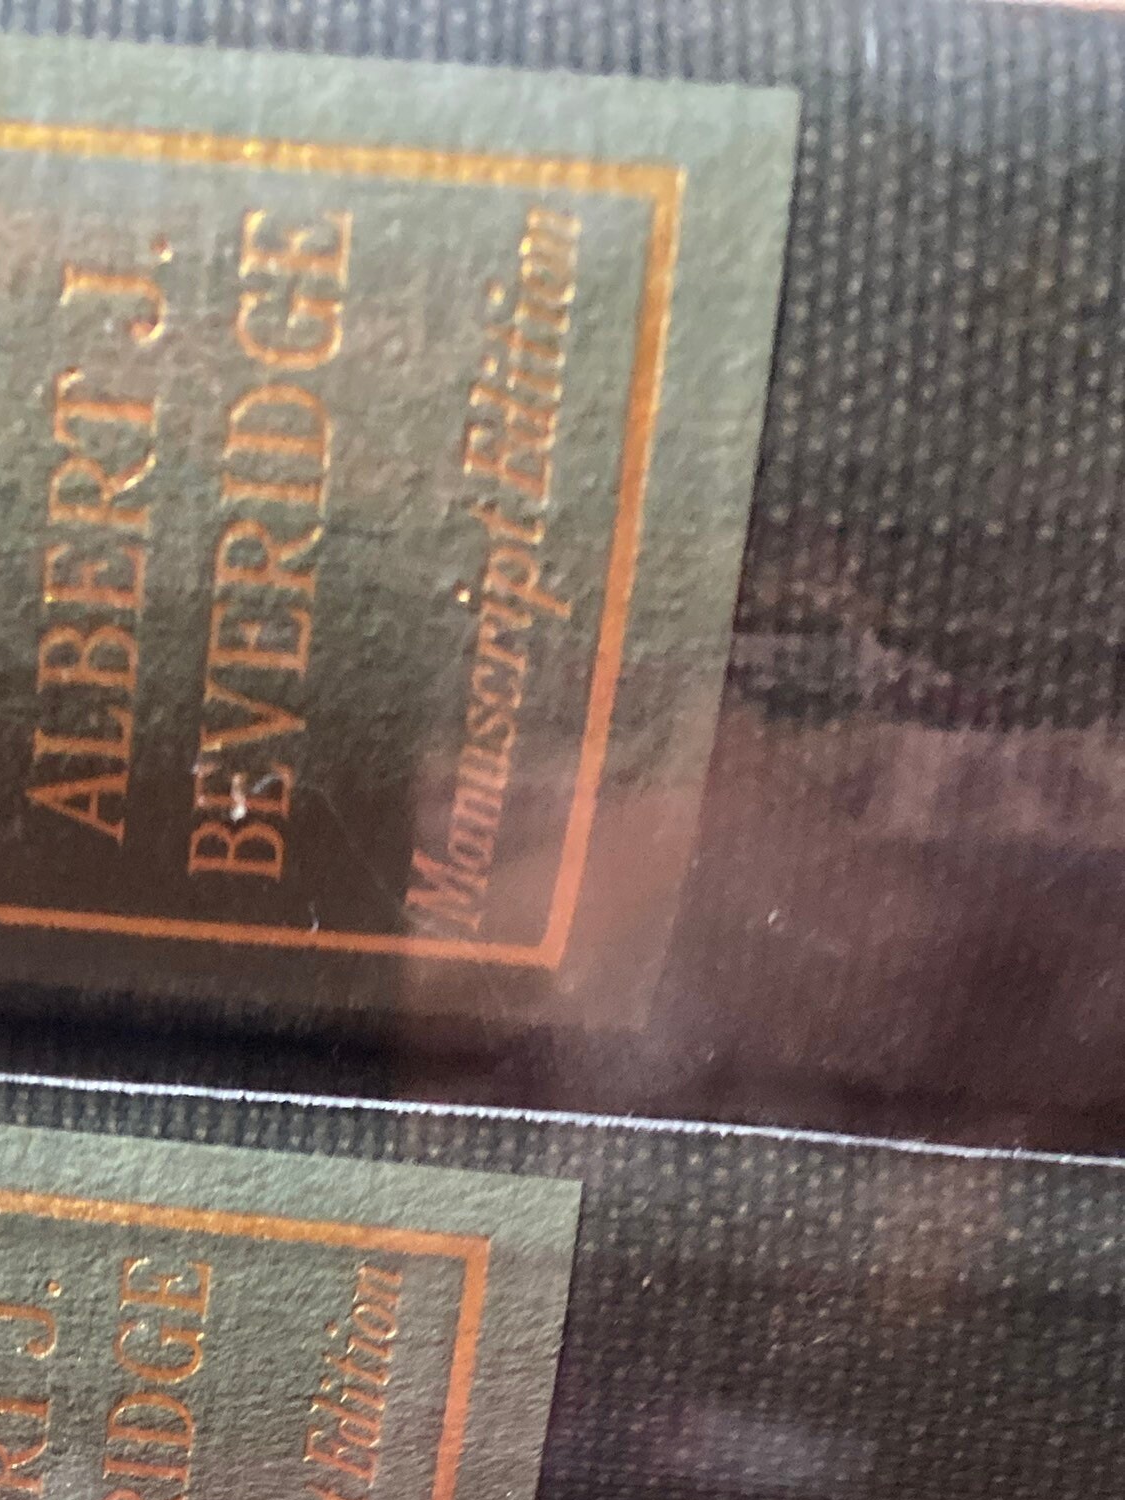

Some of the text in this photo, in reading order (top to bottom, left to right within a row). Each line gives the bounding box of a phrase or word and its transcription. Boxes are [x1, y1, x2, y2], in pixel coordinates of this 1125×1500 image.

[26, 237, 173, 844] ALBERT J.
[188, 210, 351, 882] BEVERIDGE
[406, 206, 581, 928] Manuscript Edition
[304, 1265, 402, 1487] Edition
